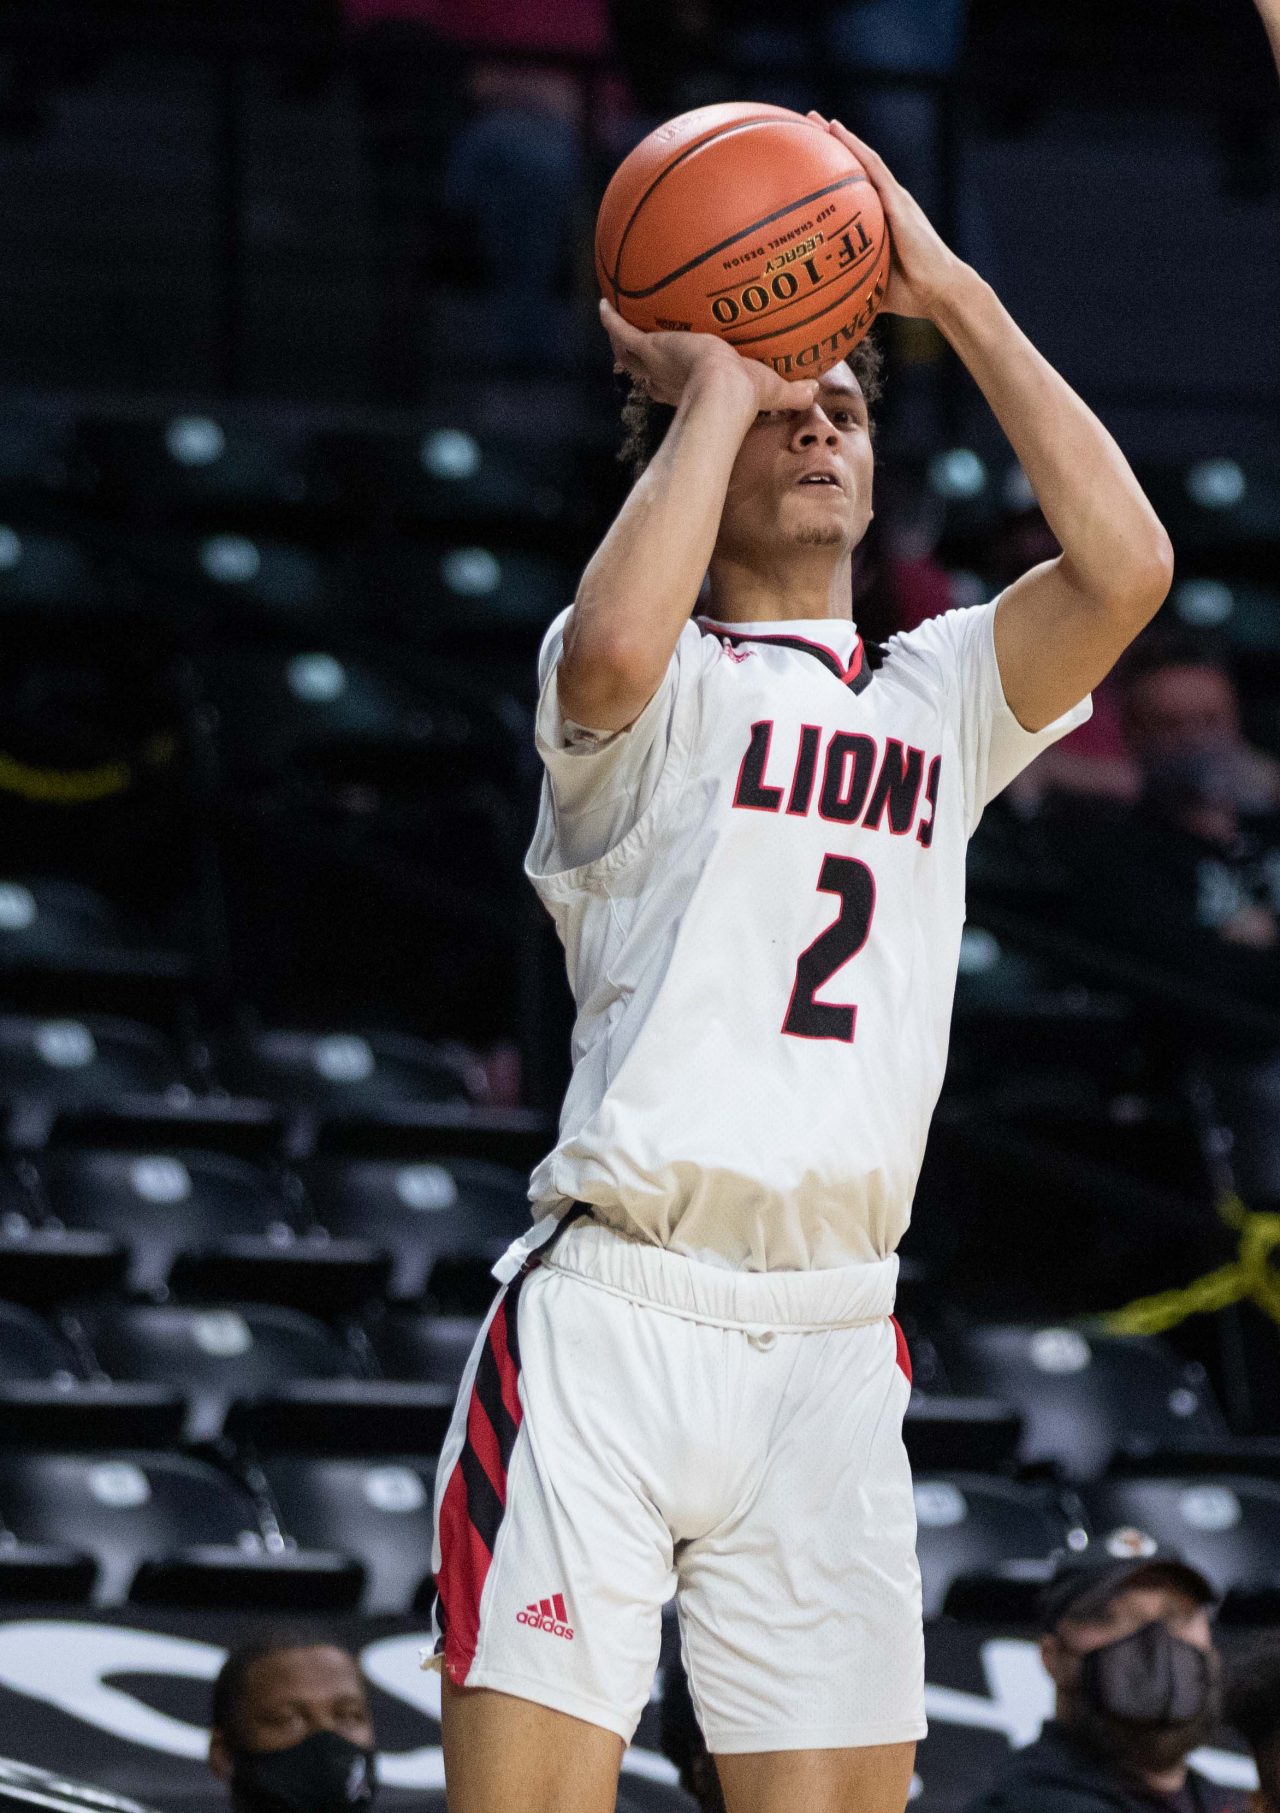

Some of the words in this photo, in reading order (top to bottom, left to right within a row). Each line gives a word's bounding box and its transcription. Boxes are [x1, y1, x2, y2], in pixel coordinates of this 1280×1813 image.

[816, 204, 836, 223] DEEP
[763, 231, 825, 278] LEGACY
[768, 221, 814, 251] CHANNEL
[711, 222, 873, 324] TF-1000
[723, 247, 766, 270] DESIGN
[732, 720, 941, 848] LIONS
[781, 852, 876, 1044] 2
[516, 1611, 574, 1640] adidas
